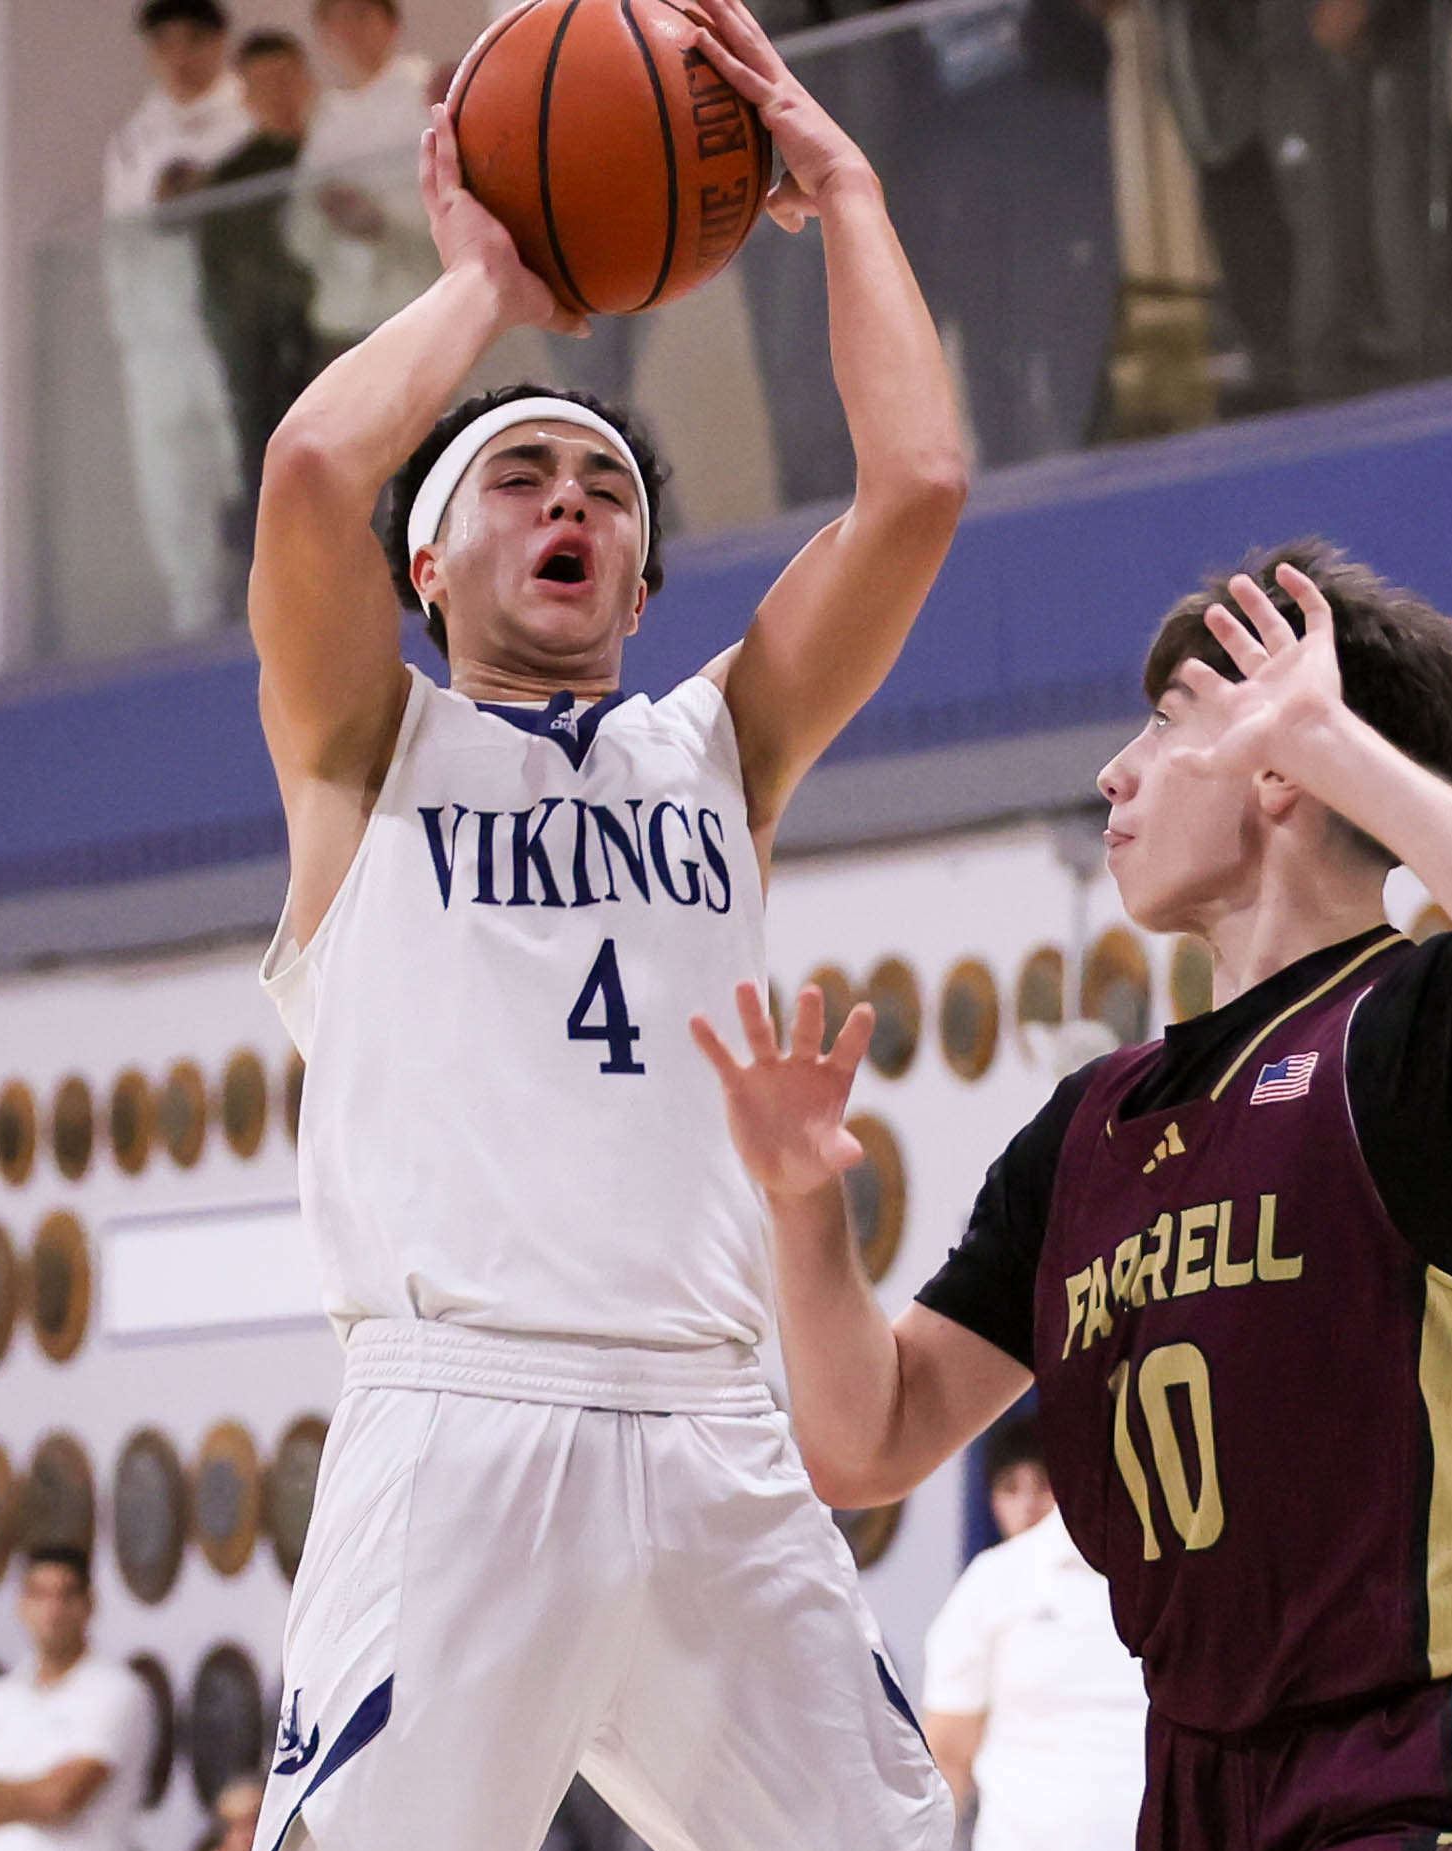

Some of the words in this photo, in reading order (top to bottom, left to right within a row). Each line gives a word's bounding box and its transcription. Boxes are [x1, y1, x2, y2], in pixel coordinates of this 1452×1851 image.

[681, 45, 749, 161] ROC
[417, 797, 731, 914] VIKINGS
[567, 938, 645, 1075] 4
[1061, 1193, 1304, 1361] FARRELL
[1108, 1341, 1225, 1561] 10
